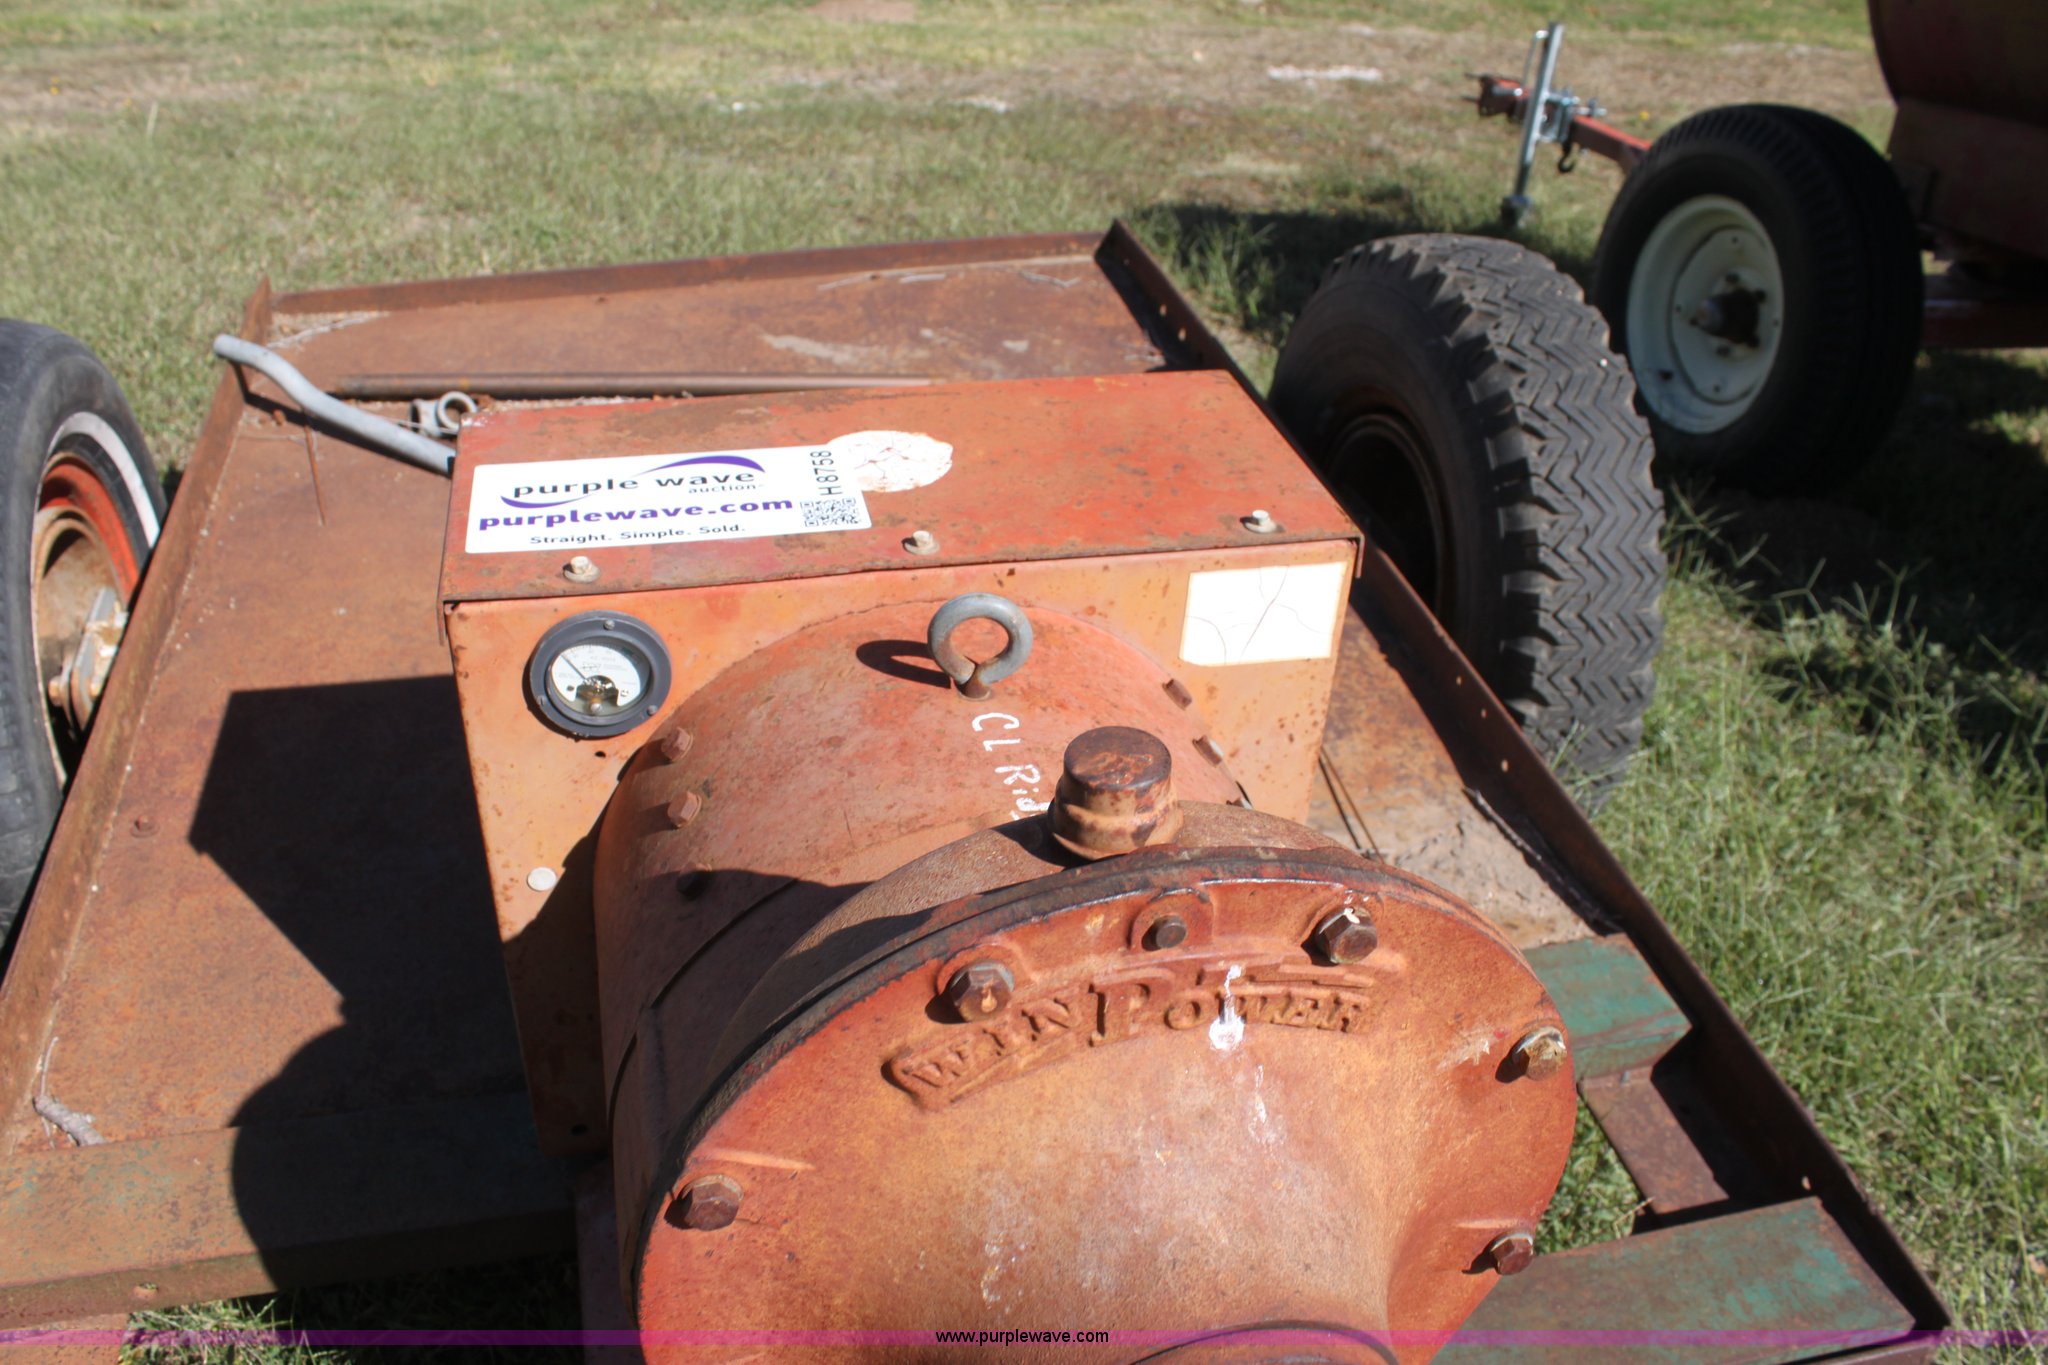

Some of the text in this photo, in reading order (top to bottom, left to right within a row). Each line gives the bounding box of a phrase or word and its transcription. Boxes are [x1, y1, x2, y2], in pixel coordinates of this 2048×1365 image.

[513, 471, 755, 498] purple wave
[810, 450, 843, 496] H8758
[688, 483, 757, 494] auction
[479, 499, 794, 531] purplewave.com
[530, 523, 746, 544] Straight. Simple. Sold.
